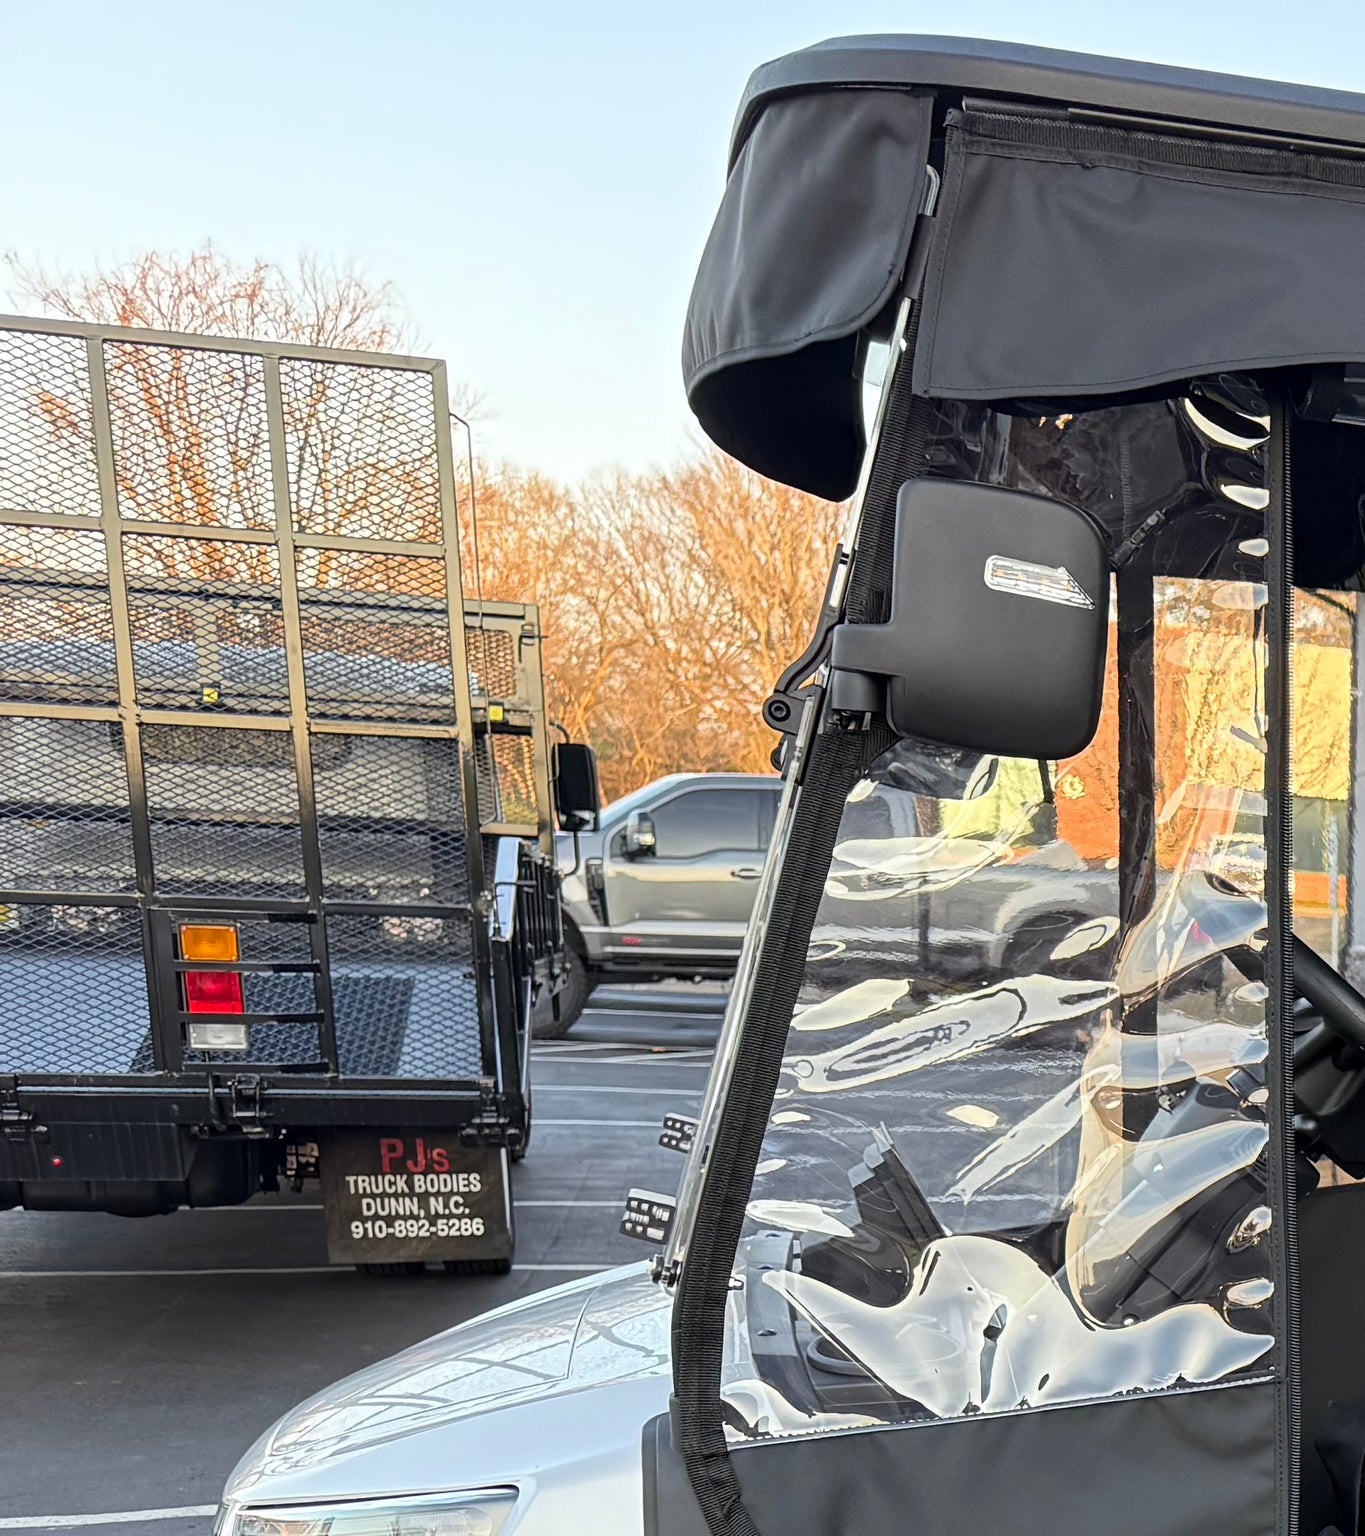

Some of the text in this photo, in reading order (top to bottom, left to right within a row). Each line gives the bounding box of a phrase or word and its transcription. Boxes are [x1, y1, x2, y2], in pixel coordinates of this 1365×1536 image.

[379, 1138, 451, 1173] PJ's
[345, 1173, 482, 1195] TRUCK BODIES
[361, 1195, 471, 1218] DUNN, N.C.
[350, 1217, 485, 1239] 910-892-5286
